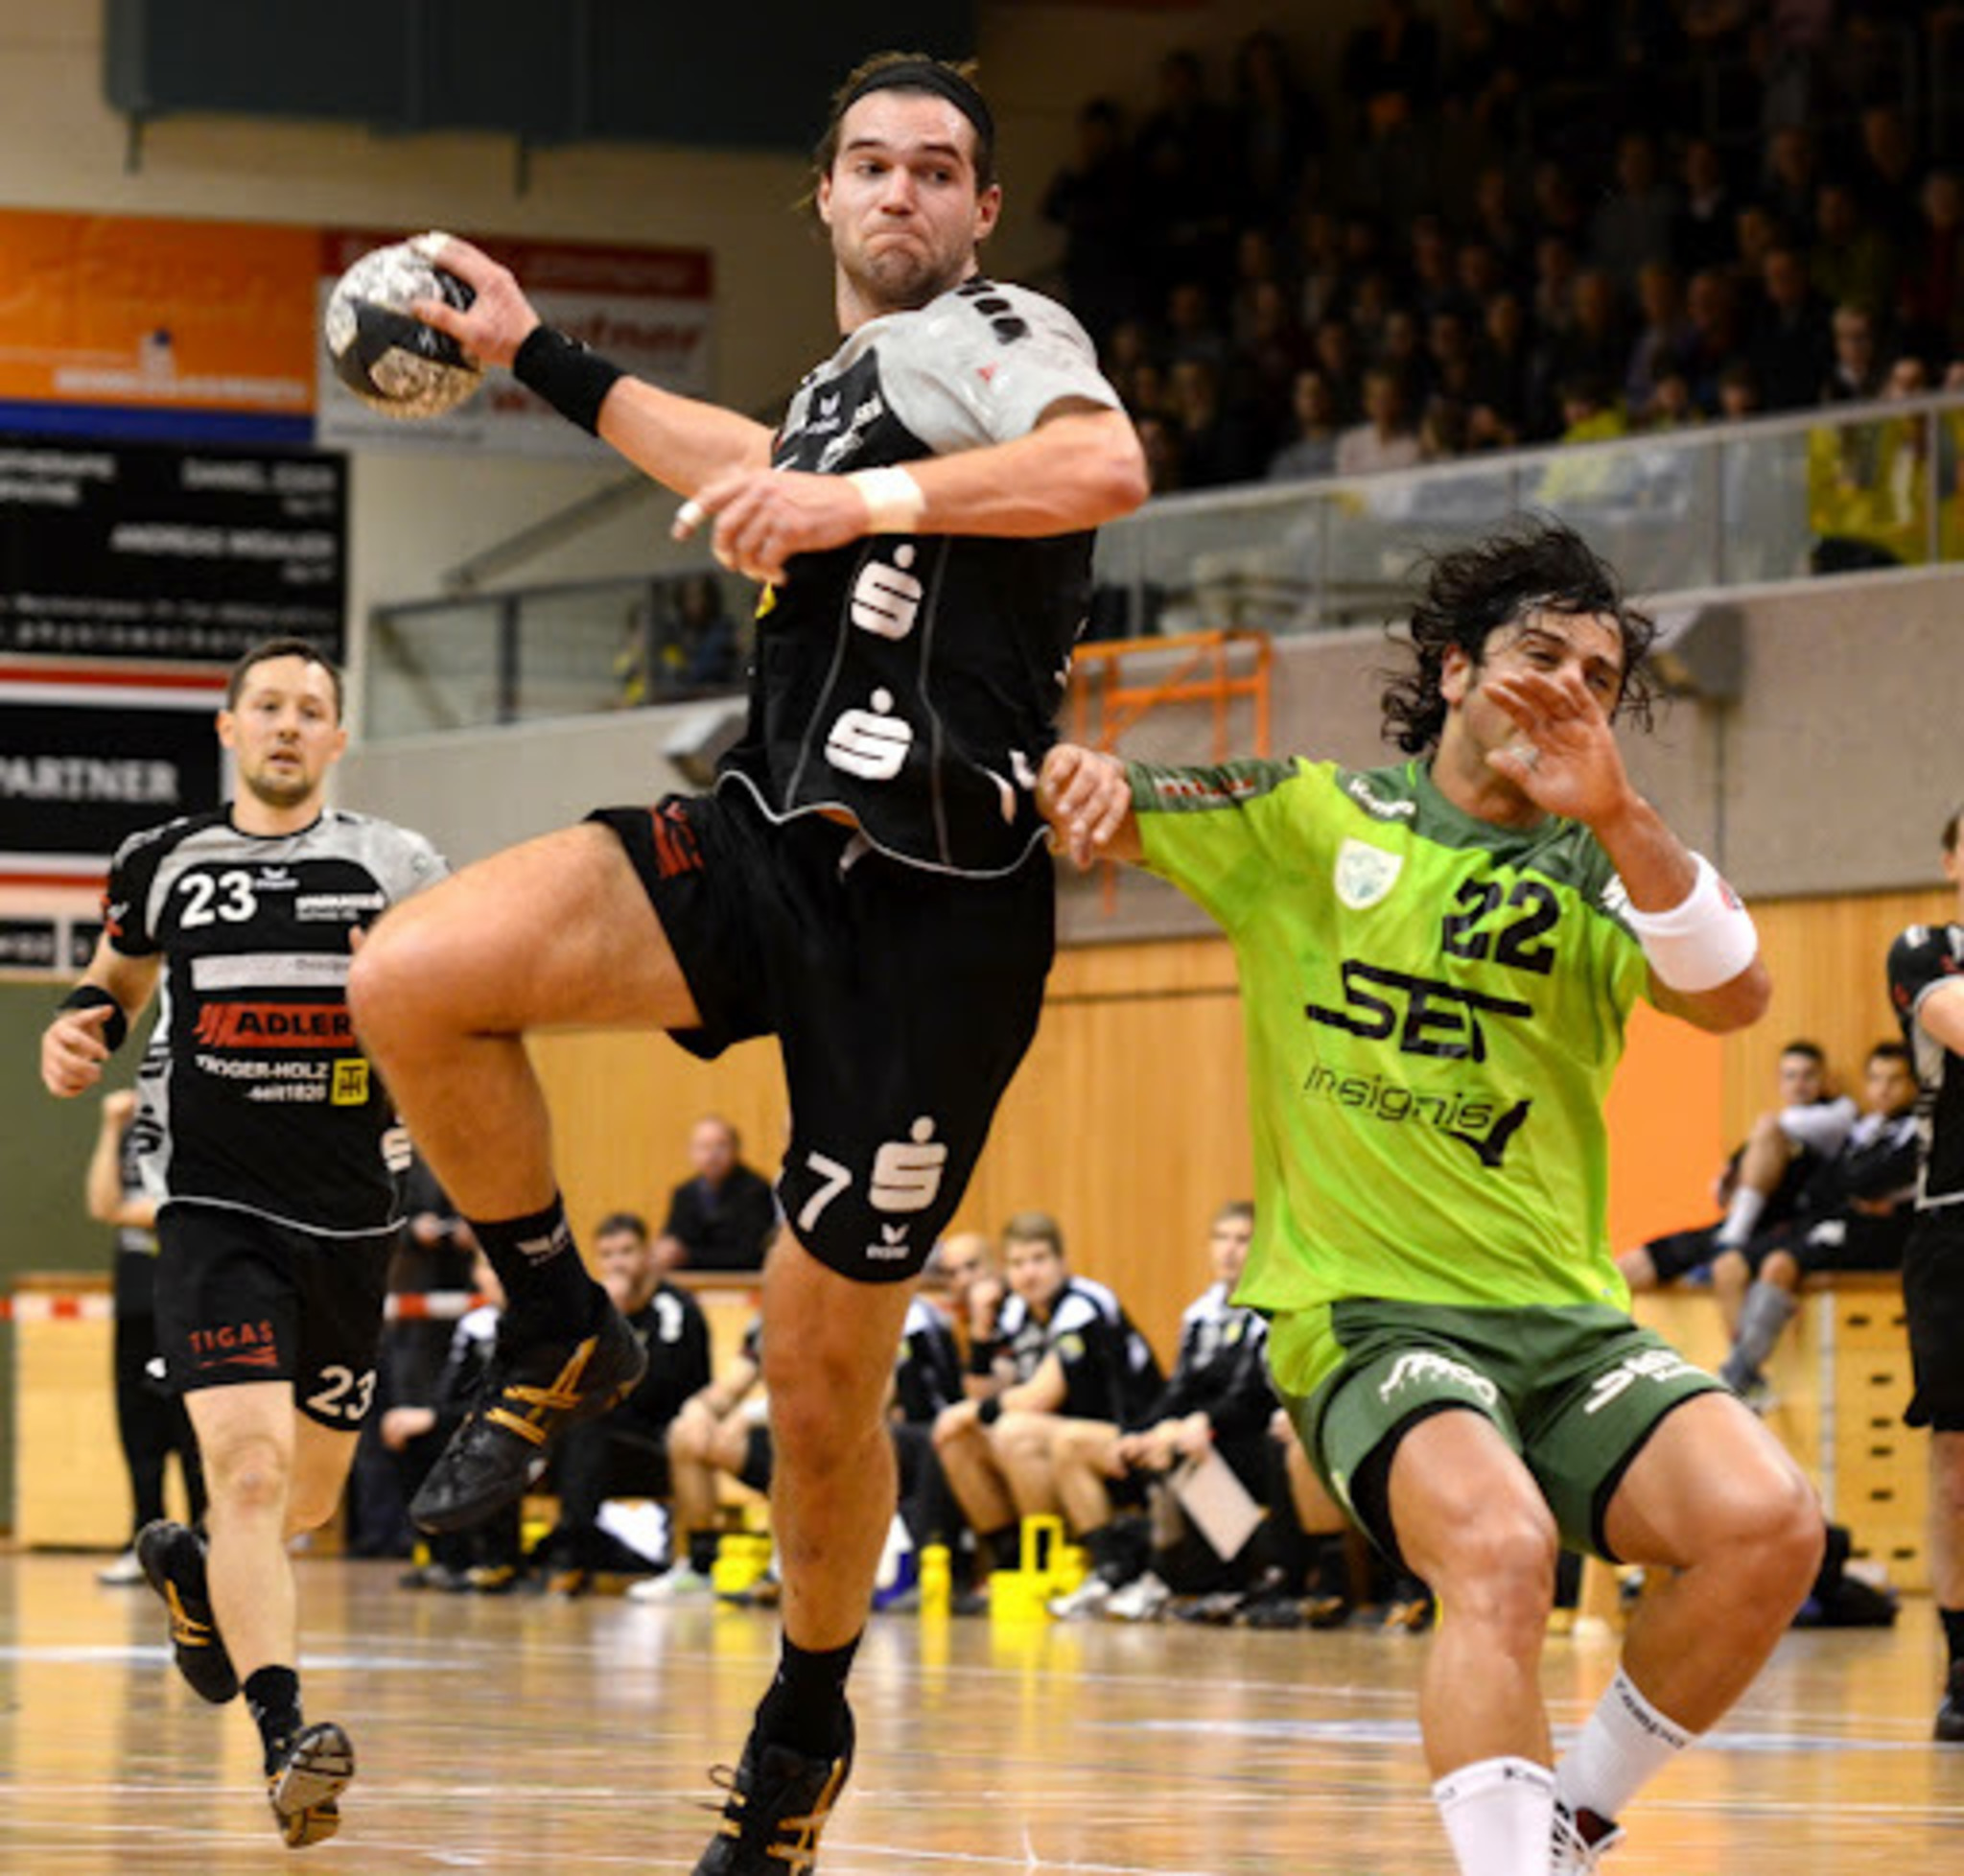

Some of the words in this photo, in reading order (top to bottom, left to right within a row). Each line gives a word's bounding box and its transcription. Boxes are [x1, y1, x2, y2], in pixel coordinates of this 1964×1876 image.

[178, 871, 256, 929] 23
[1441, 878, 1561, 975] 22
[235, 1013, 351, 1036] ADLER
[1305, 959, 1533, 1064] SET
[797, 1151, 853, 1233] 7
[307, 1366, 377, 1419] 23
